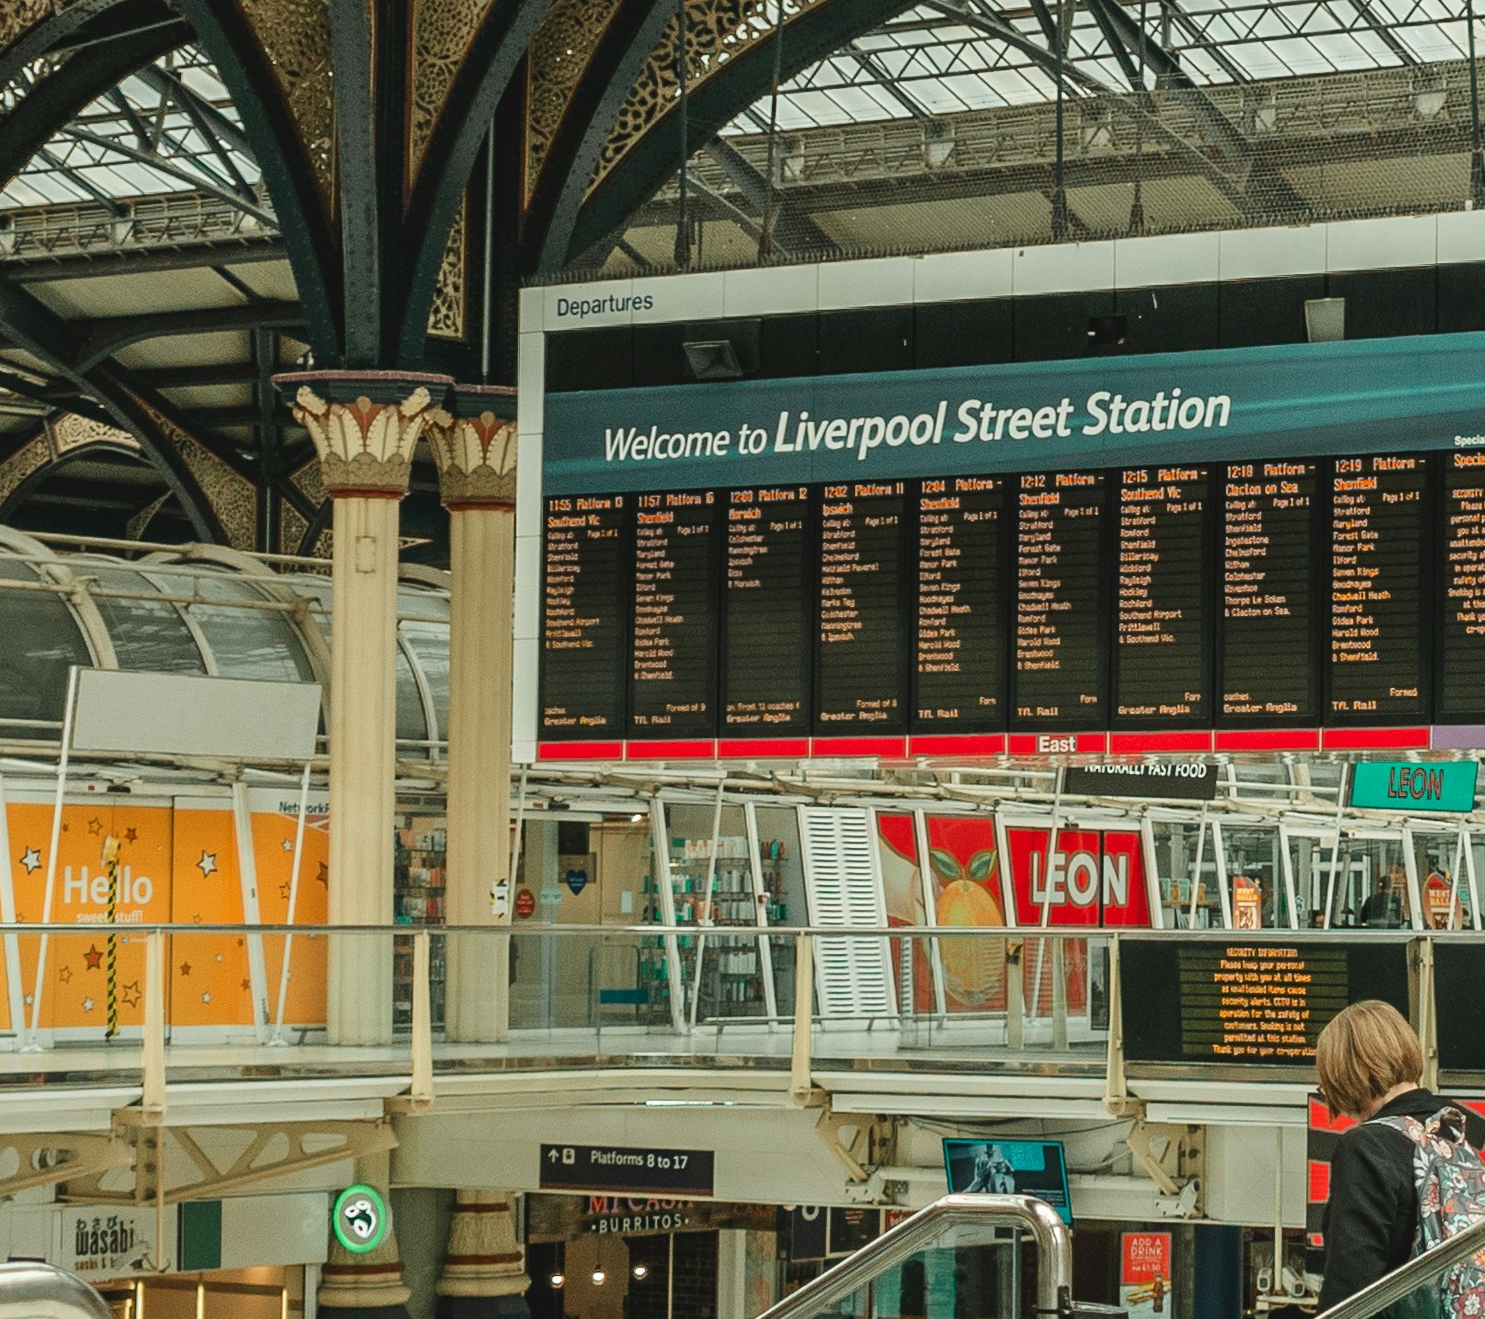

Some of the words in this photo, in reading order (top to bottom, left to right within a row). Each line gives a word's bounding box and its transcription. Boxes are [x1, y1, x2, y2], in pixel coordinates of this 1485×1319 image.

[555, 292, 655, 318] Departures
[602, 419, 729, 463] Welcome
[737, 427, 768, 455] to
[773, 399, 946, 460] Liverpool
[953, 393, 1074, 444] Street
[1082, 386, 1233, 438] Station
[1037, 736, 1076, 753] East
[1148, 764, 1173, 778] FAST
[1175, 763, 1207, 779] FOOD
[1388, 766, 1444, 799] LEON
[63, 864, 154, 905] Hello
[1031, 851, 1128, 907] LEON
[591, 1150, 644, 1166] Platforms
[647, 1154, 654, 1168] 8
[657, 1155, 670, 1169] to
[673, 1155, 688, 1170] 17
[599, 1214, 682, 1233] BURRITOS
[75, 1220, 134, 1256] wasabi
[1132, 1237, 1153, 1247] ADD
[1155, 1237, 1162, 1247] A
[1130, 1246, 1163, 1256] DRINK
